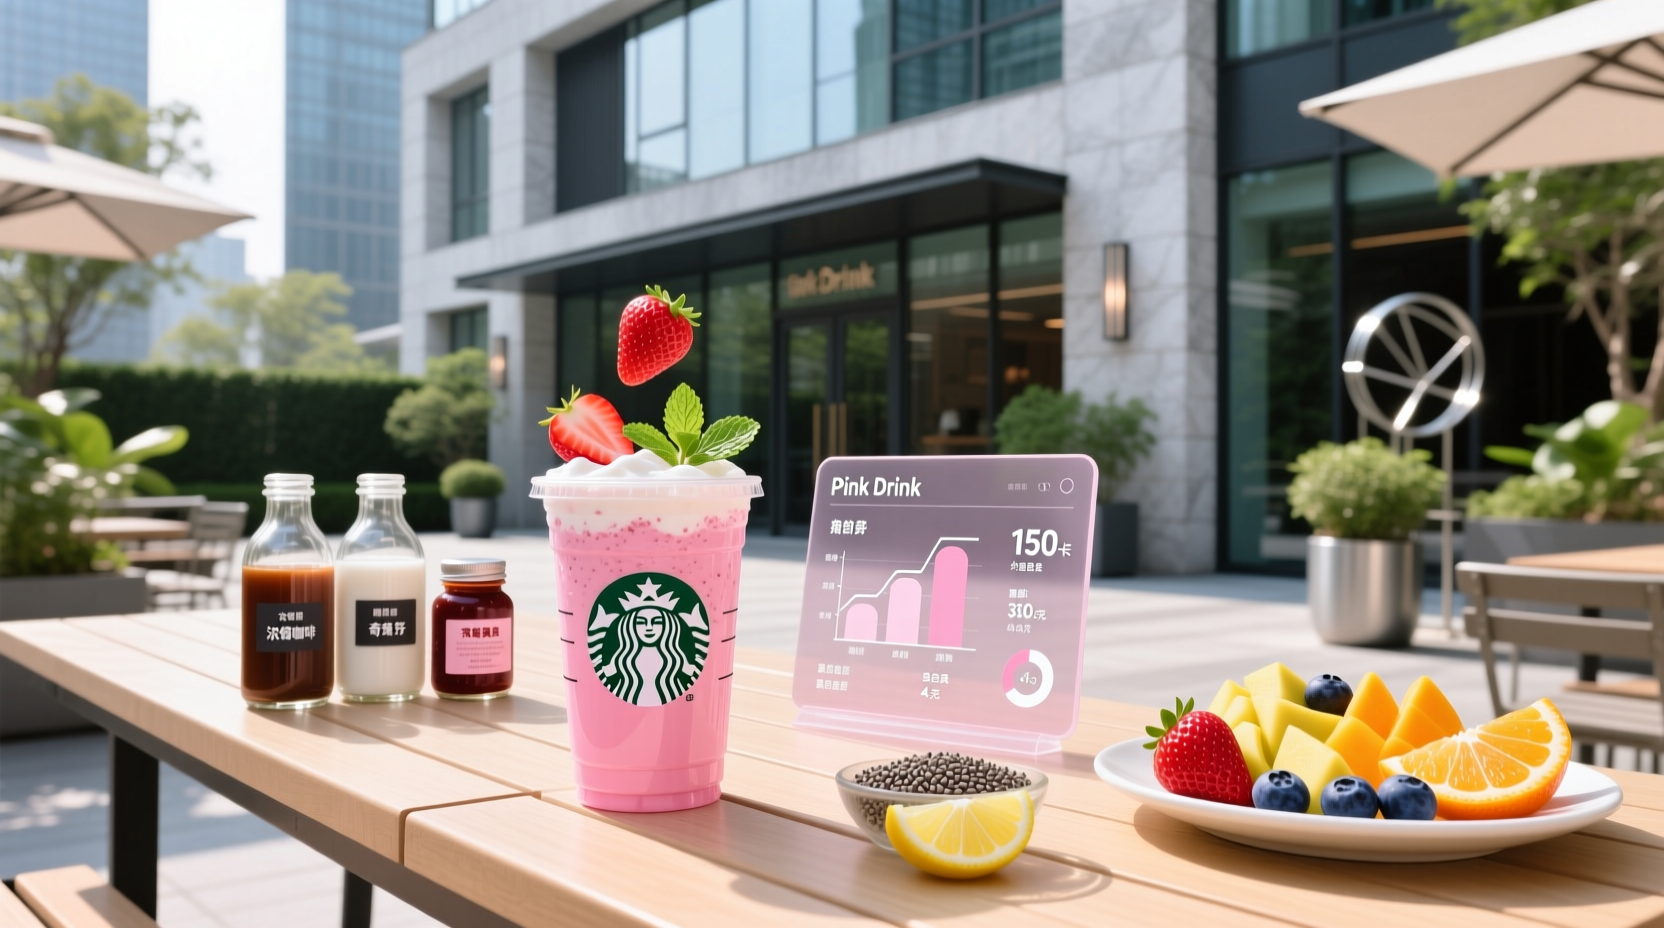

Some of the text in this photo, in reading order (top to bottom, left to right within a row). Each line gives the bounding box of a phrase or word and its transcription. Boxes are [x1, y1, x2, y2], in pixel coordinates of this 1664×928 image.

[819, 261, 875, 294] Drink
[831, 476, 921, 497] Pink Drink
[1011, 528, 1072, 557] 150卡
